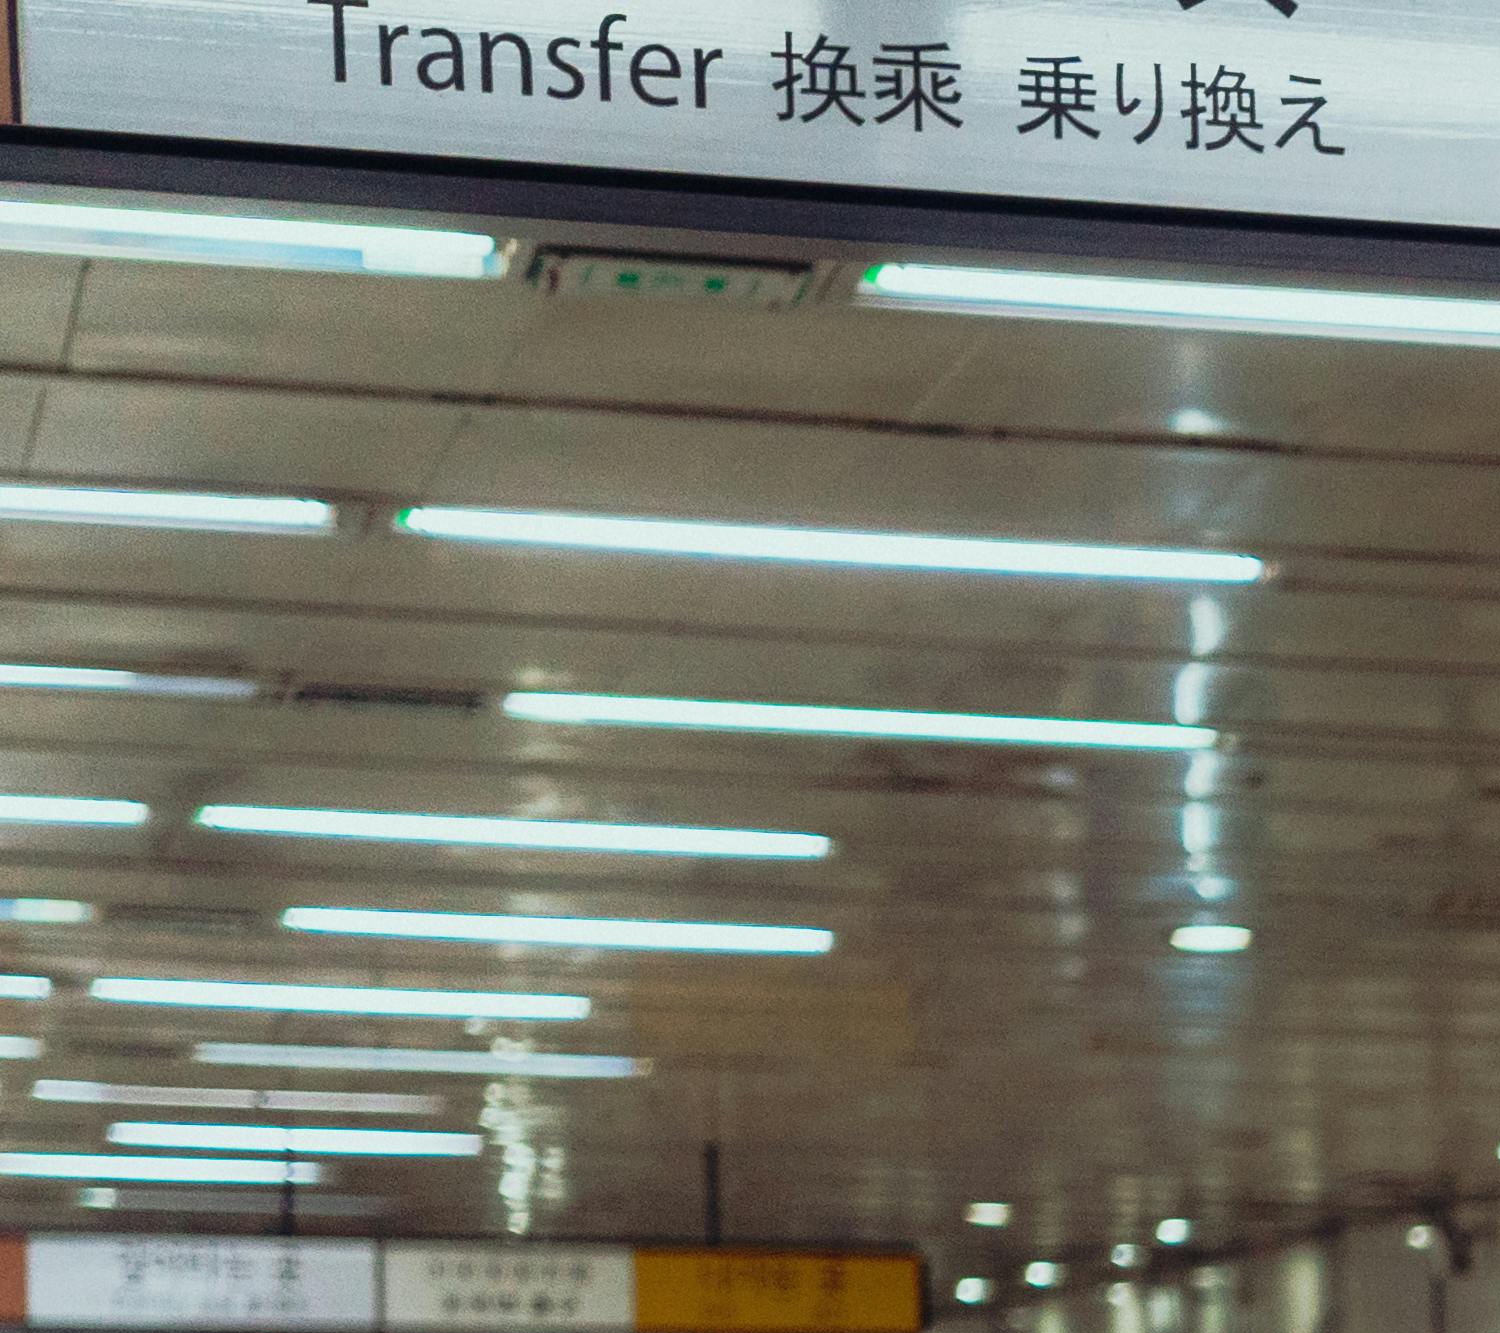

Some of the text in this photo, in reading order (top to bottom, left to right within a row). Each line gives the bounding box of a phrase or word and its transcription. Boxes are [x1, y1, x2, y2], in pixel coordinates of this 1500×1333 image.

[306, 0, 1346, 157] Transfer 换乘 乗り換え
